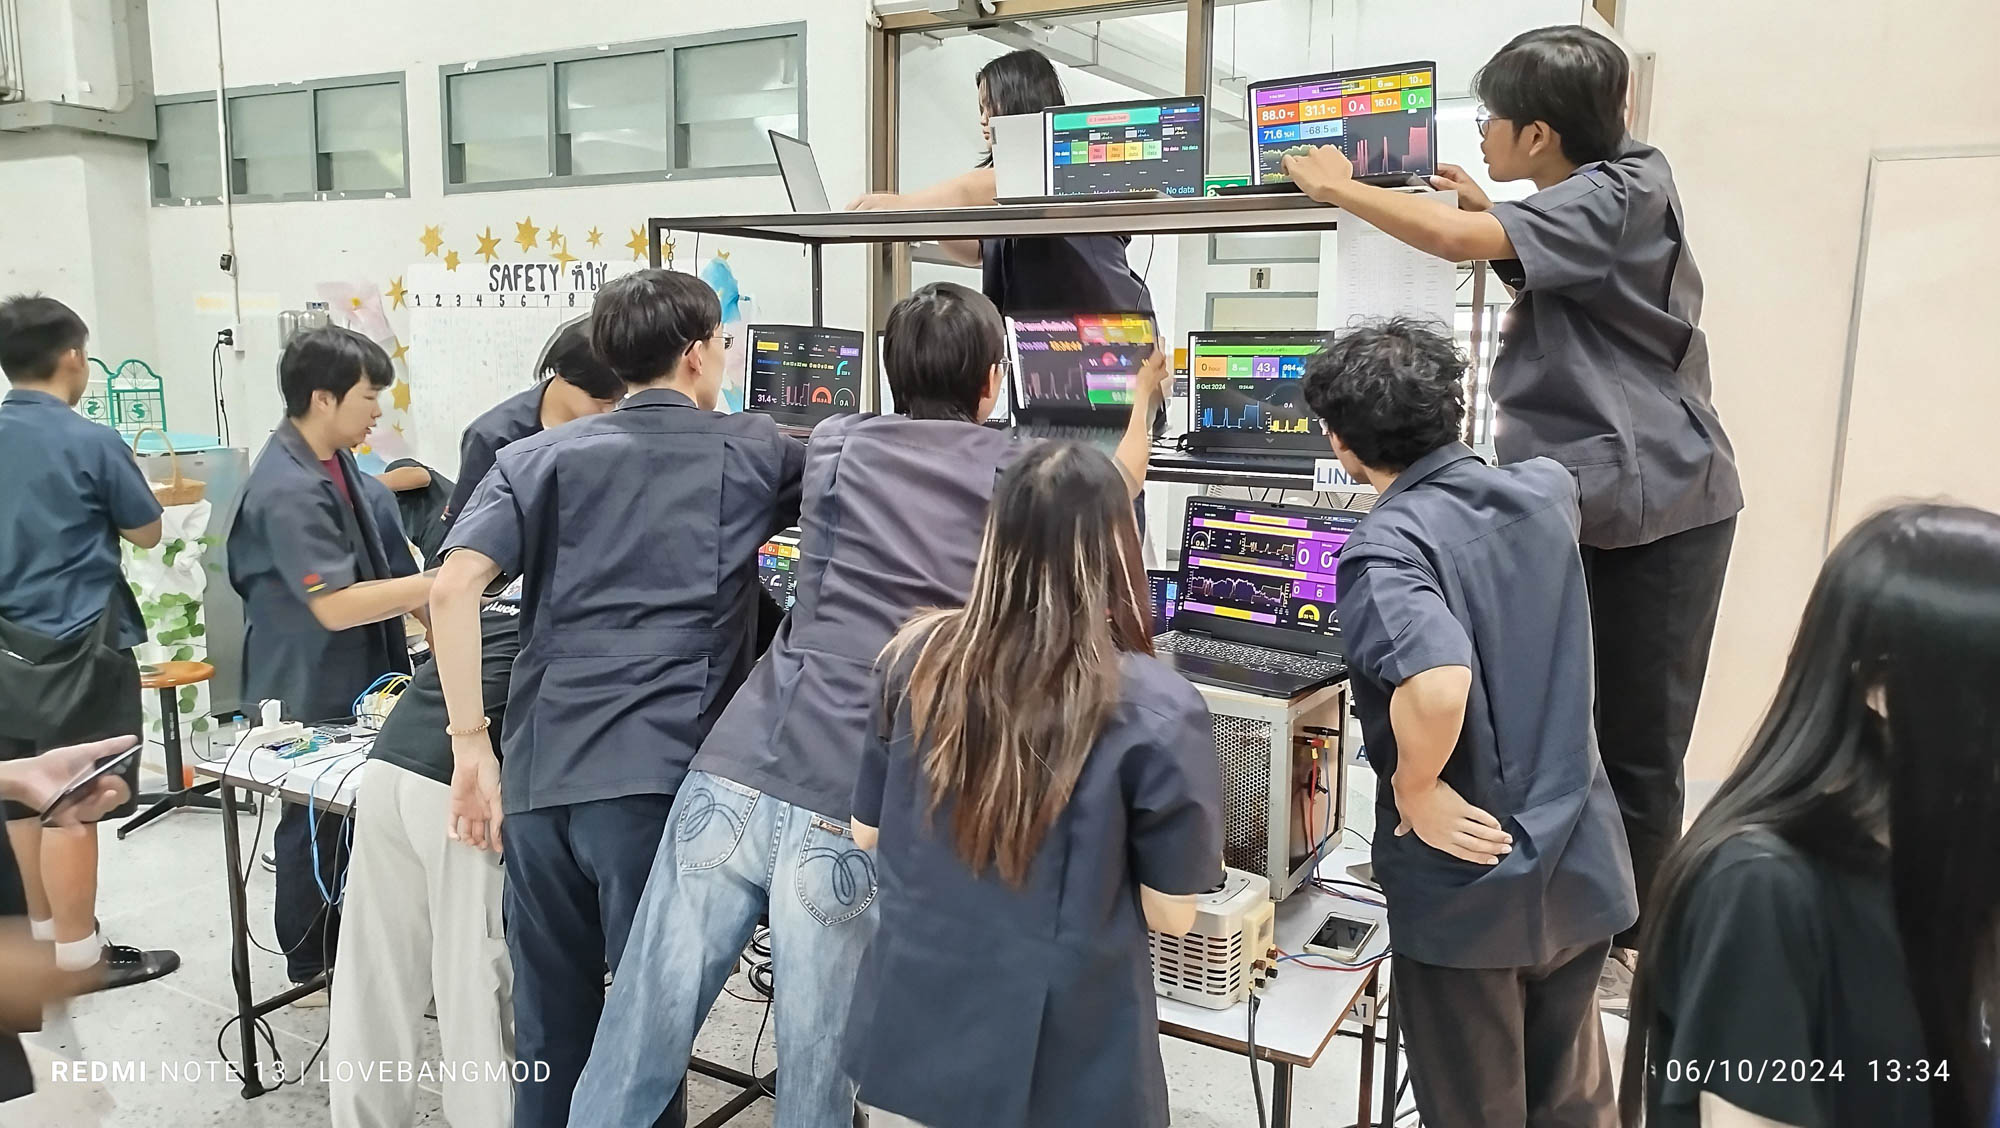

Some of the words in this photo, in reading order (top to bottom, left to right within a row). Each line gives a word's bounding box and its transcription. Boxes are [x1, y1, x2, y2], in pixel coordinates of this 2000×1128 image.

[1348, 100, 1357, 112] 0
[1408, 94, 1416, 106] 0
[1262, 109, 1286, 121] 88.0
[1304, 104, 1326, 117] 31.1
[1263, 130, 1282, 140] 71.6
[1166, 186, 1178, 194] No
[1180, 186, 1194, 194] data
[489, 263, 560, 292] SAFETY
[415, 294, 421, 307] 1
[435, 294, 442, 308] 2
[456, 294, 461, 308] 3
[477, 294, 483, 308] 4
[499, 294, 505, 308] 5
[520, 294, 526, 308] 6
[544, 294, 550, 308] 7
[568, 292, 575, 308] 8
[1202, 364, 1208, 372] 0
[1256, 362, 1271, 372] 43
[758, 394, 771, 403] 31.4
[1298, 548, 1310, 565] 0
[1321, 551, 1333, 568] 0
[1294, 586, 1300, 594] 0
